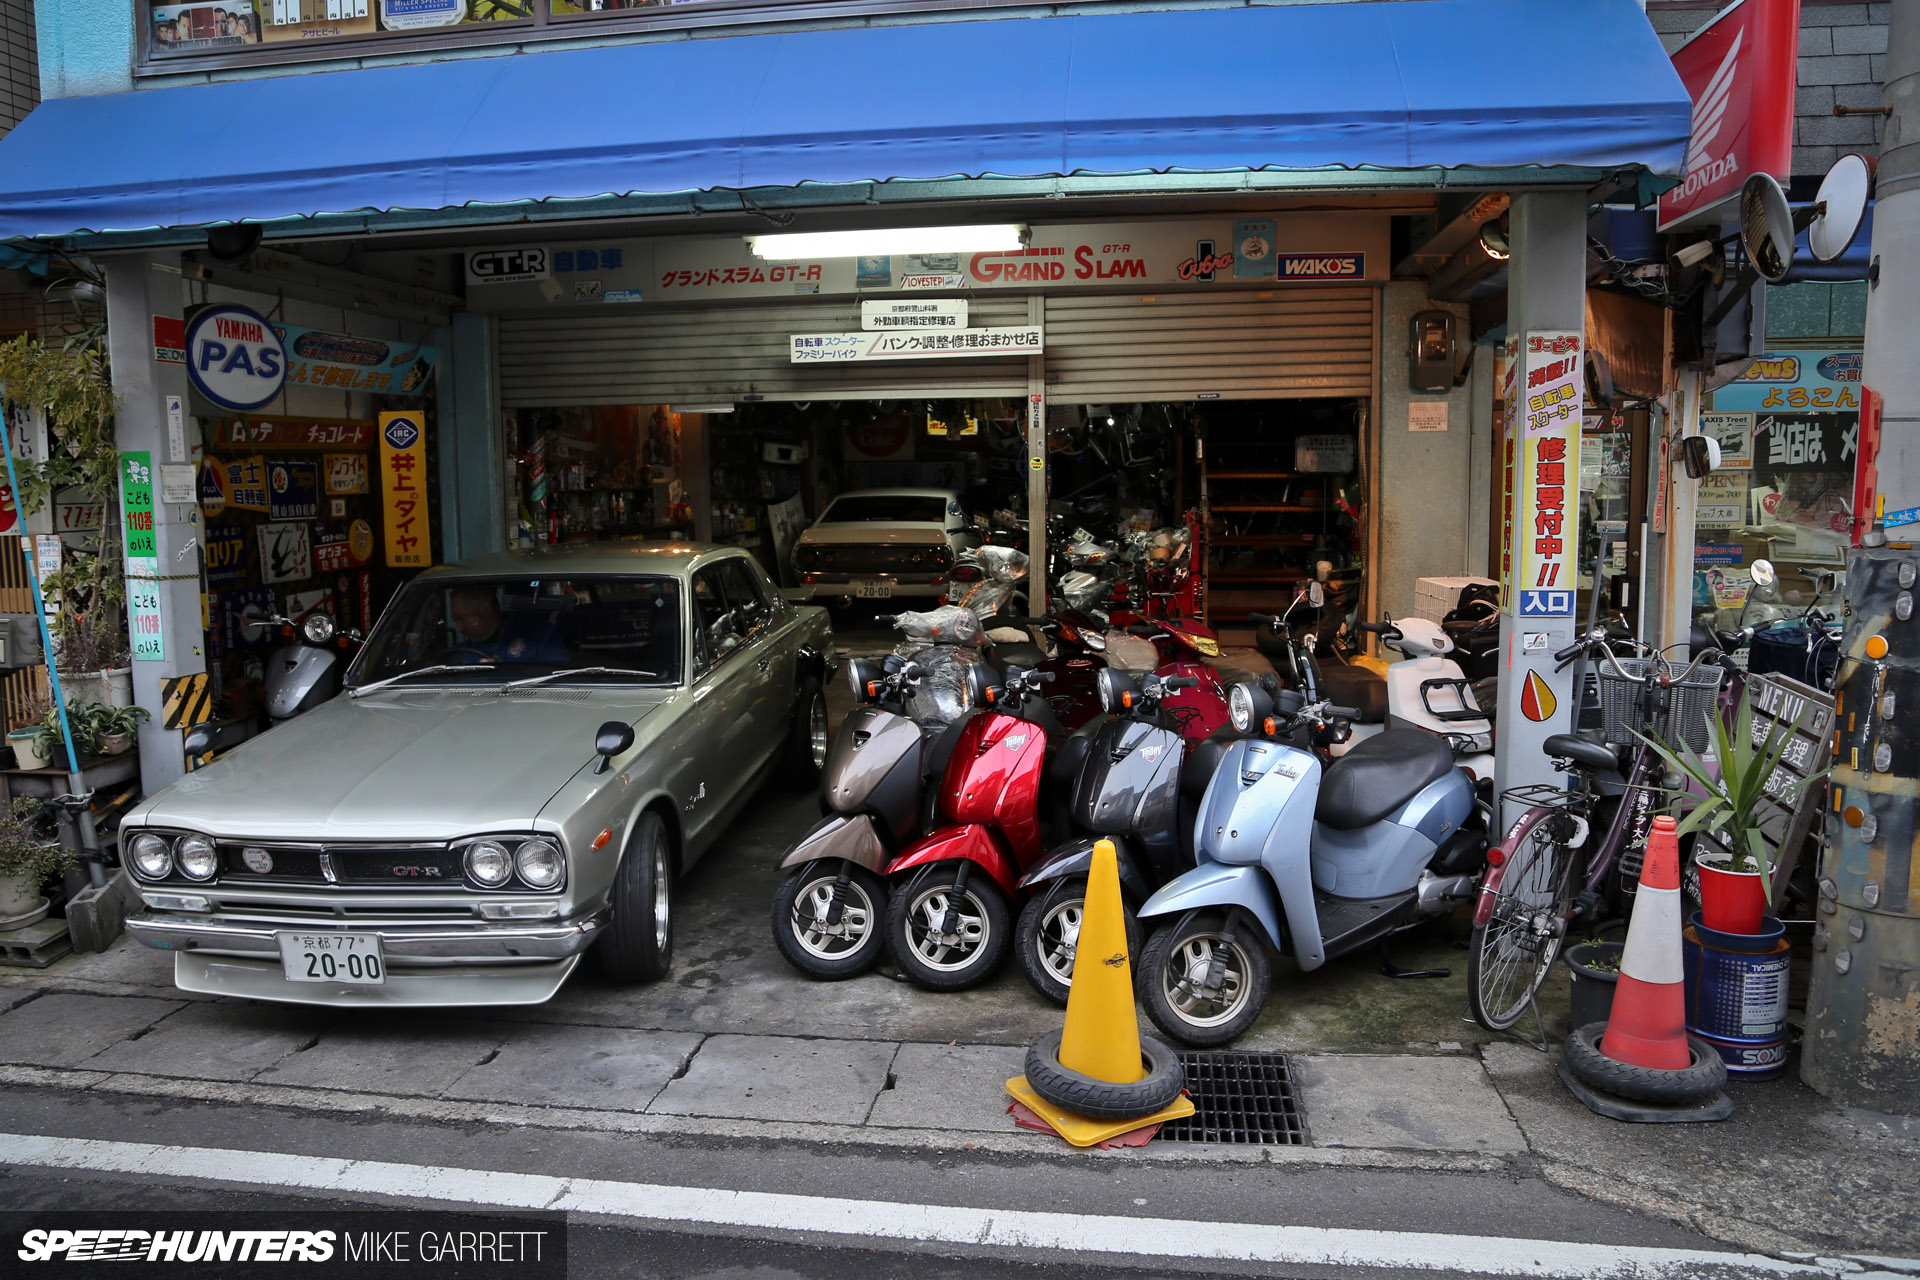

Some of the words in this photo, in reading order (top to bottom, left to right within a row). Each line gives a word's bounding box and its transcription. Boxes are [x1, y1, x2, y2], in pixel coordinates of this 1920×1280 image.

[301, 28, 340, 38] アサヒビール
[1672, 153, 1739, 203] HONDA
[1102, 244, 1131, 253] GT-R
[554, 248, 623, 272] 自動車
[970, 248, 1065, 283] GRAND
[1074, 245, 1147, 280] SLAM
[662, 267, 765, 288] グランドスラム
[770, 265, 822, 282] GT-R
[215, 318, 264, 343] YAMAHA
[795, 337, 823, 348] 自転車
[825, 336, 866, 346] スクーター
[1527, 336, 1580, 354] サービス
[156, 348, 185, 361] SECOM
[199, 340, 281, 379] PAS
[795, 349, 857, 359] ファミリーバイク
[1528, 355, 1577, 389] 満載!!
[1528, 383, 1577, 412] 自転車
[1762, 387, 1859, 408] よろこん
[1526, 404, 1579, 430] スクーター
[232, 420, 273, 442] ロッテ
[308, 424, 363, 444] チョコレート
[393, 429, 409, 438] IRC
[228, 460, 261, 486] 富士
[326, 457, 365, 475] サンライト
[126, 491, 150, 505] こども
[203, 485, 217, 493] FUJI
[126, 511, 152, 531] 110番
[130, 537, 153, 551] のいえ
[134, 595, 157, 608] こども
[1525, 591, 1570, 613] 入口
[134, 615, 160, 634] 110番
[138, 639, 161, 654] のいえ
[1758, 684, 1804, 724] MENU
[1003, 733, 1028, 748] Today
[1139, 745, 1163, 758] Today
[392, 866, 442, 877] GT-R
[302, 936, 331, 949] 京都
[333, 936, 355, 950] 77
[304, 952, 380, 980] 20-00
